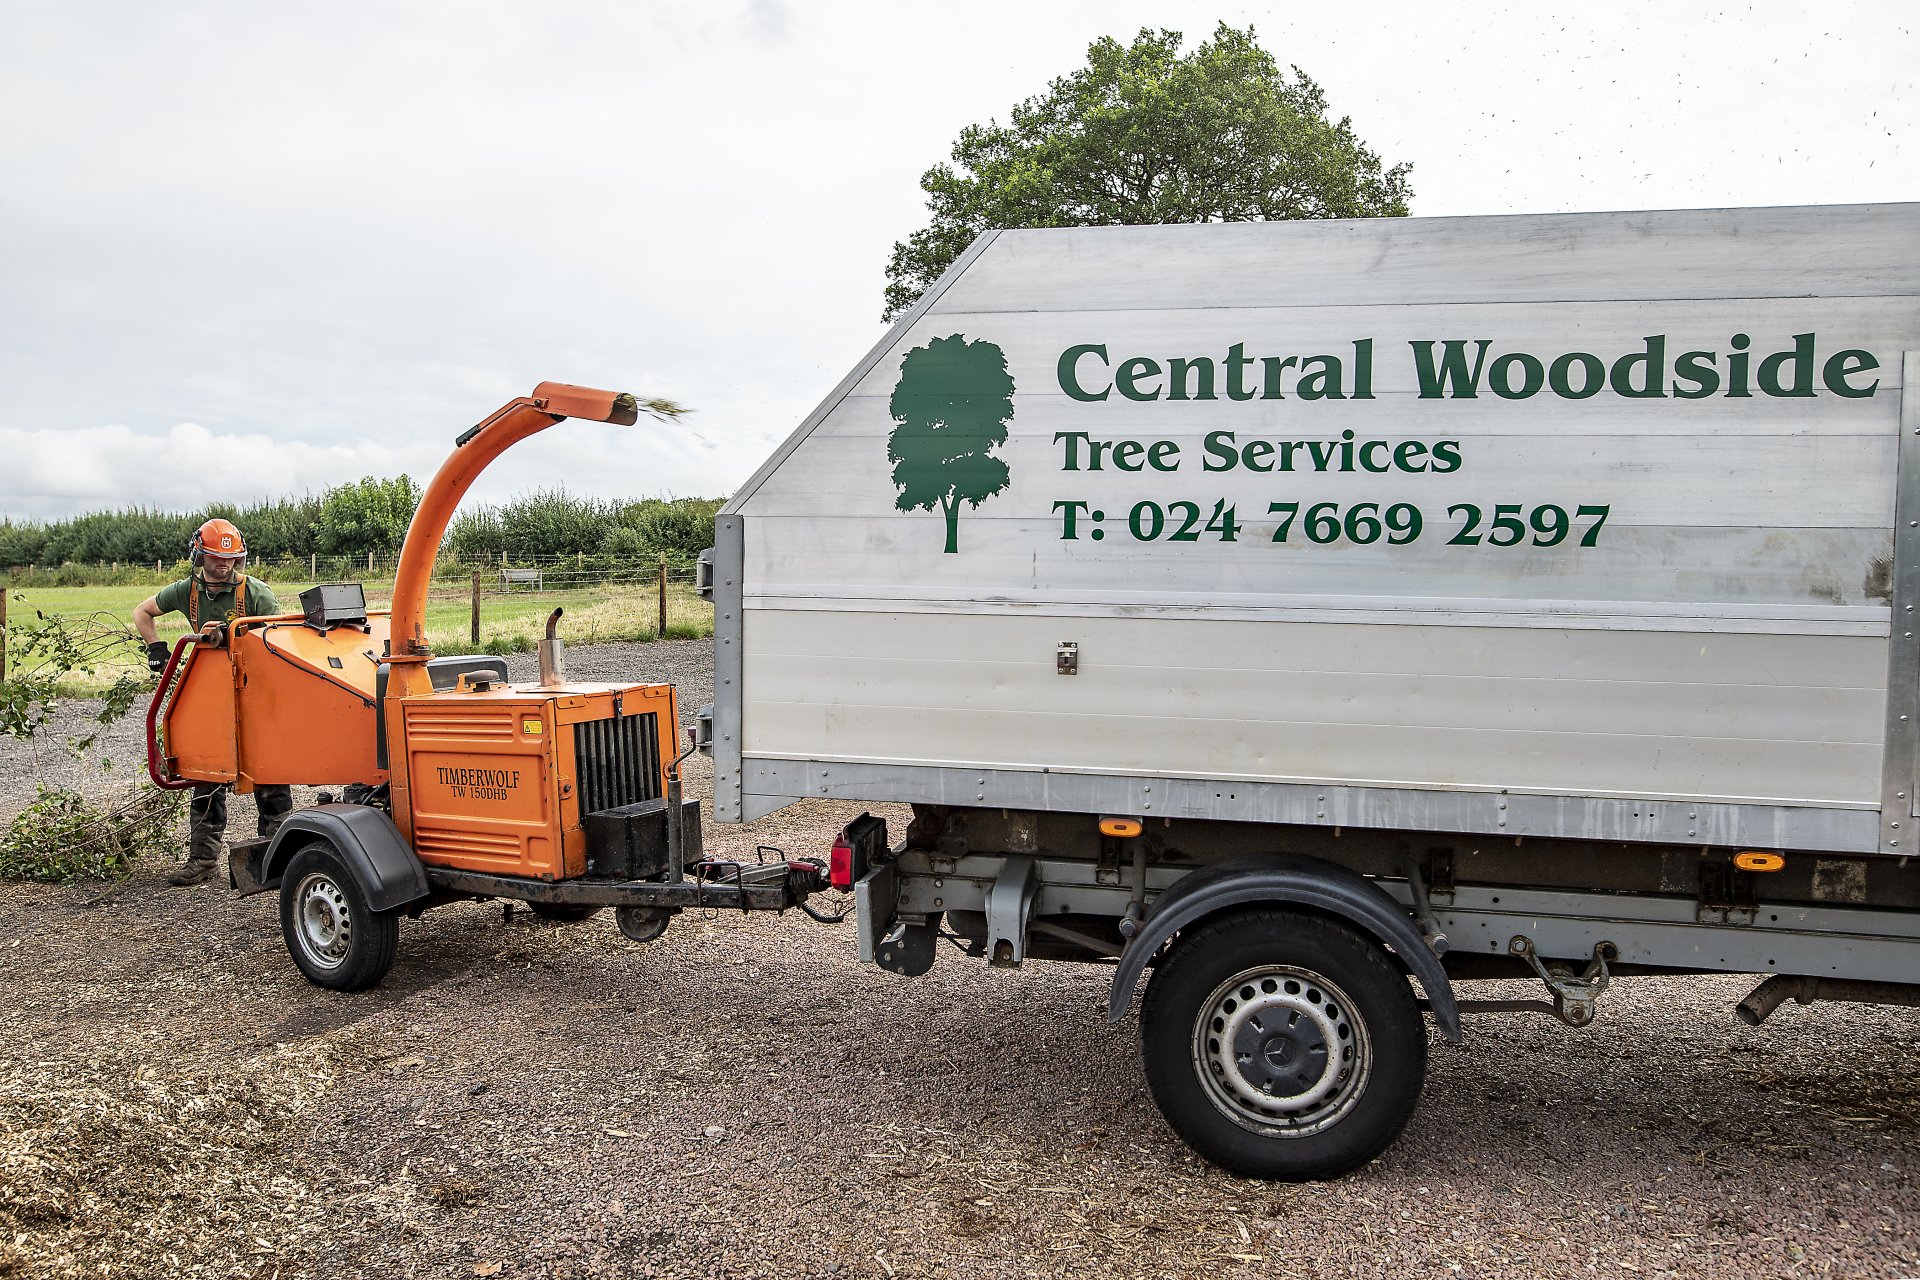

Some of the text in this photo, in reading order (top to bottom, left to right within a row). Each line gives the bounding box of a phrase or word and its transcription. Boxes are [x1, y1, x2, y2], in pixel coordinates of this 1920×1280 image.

[1057, 332, 1880, 402] Central Woodside
[1053, 429, 1463, 473] Tree Services
[1052, 498, 1611, 548] T: 024 7669 2597
[436, 767, 520, 788] TIMBERWOLF
[451, 786, 508, 801] TW 150DHB
